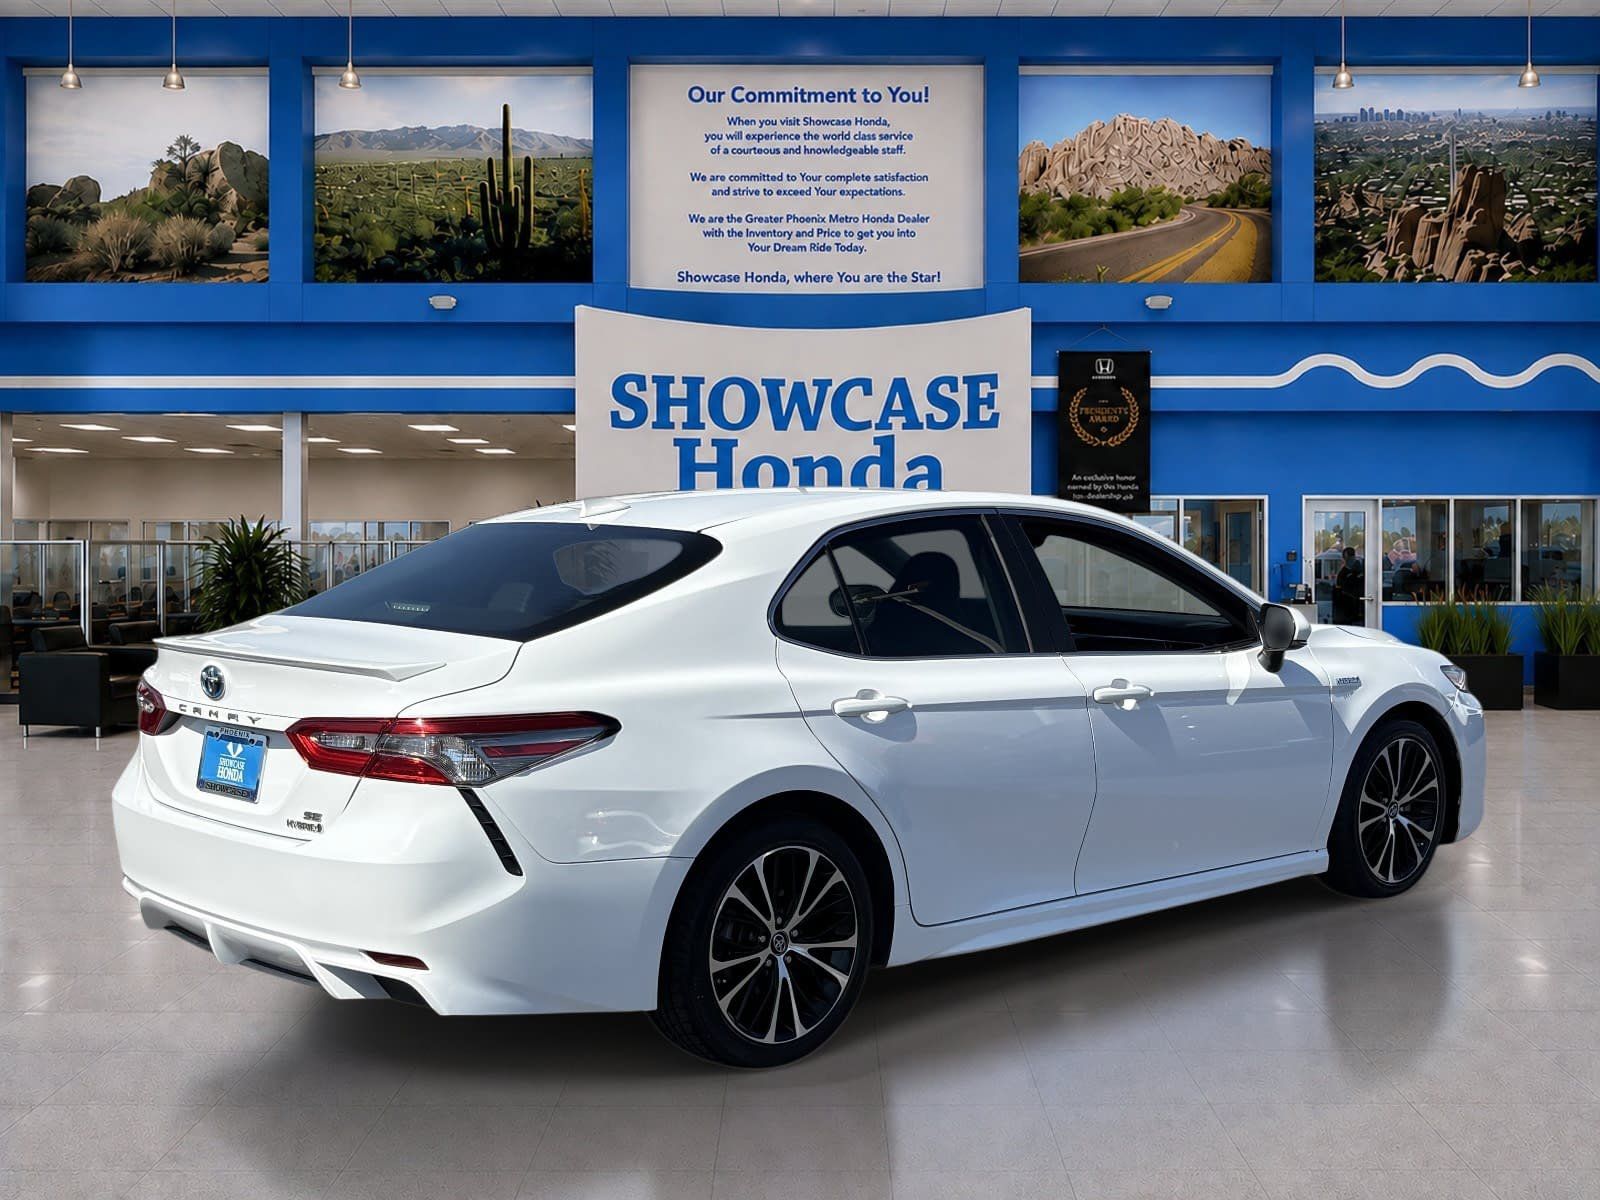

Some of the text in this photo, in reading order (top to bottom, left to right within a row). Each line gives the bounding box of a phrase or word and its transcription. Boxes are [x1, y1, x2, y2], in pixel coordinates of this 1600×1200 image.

[687, 85, 930, 104] Our Commitment to You!
[726, 116, 891, 129] When you visit Showcase Honda,
[704, 130, 914, 144] you will experience the world class service
[709, 144, 721, 155] of
[722, 147, 730, 155] a
[730, 146, 781, 155] courteous
[782, 144, 802, 155] and
[881, 144, 906, 155] staff.
[689, 171, 929, 183] We are committed to Your complete satisfaction
[711, 186, 906, 199] and strive to exceed Your expectations.
[688, 213, 931, 224] We are the Greater Phoenix Metro Honda Dealer
[702, 227, 917, 241] with the Inventory and Price to get you into
[747, 242, 867, 254] Your Dream Ride Today.
[677, 270, 941, 285] Showcase Honda, where You are the Star!
[610, 373, 1000, 431] SHOWCASE
[673, 434, 942, 490] Honda
[178, 703, 262, 725] CAMRY
[219, 727, 250, 739] PHOENIX
[218, 756, 245, 771] SHOWCASE
[216, 765, 244, 783] HONDA
[205, 781, 249, 798] SHOWCASE
[303, 811, 323, 822] SE
